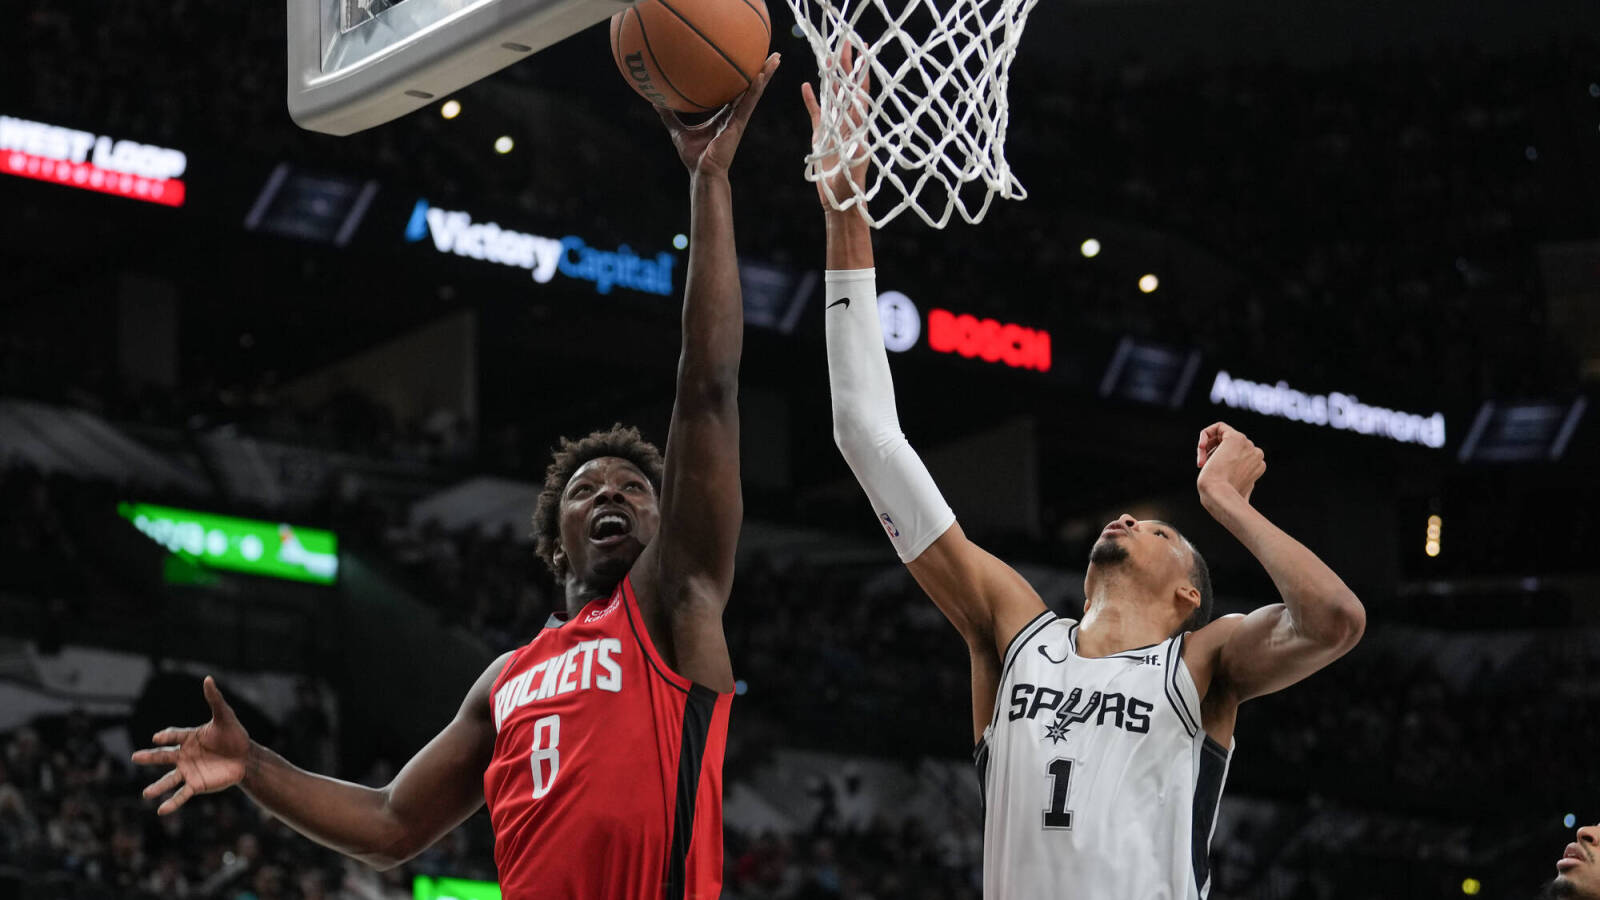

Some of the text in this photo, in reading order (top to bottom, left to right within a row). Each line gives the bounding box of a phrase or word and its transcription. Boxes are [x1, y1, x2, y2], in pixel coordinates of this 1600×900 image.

[92, 135, 187, 180] LOOP
[928, 308, 1051, 372] BOSCH
[1210, 371, 1446, 448] Americus Diamond
[494, 638, 622, 734] ROCKETS
[1008, 683, 1154, 745] SPURS
[530, 714, 561, 799] 8
[1042, 756, 1075, 831] 1
